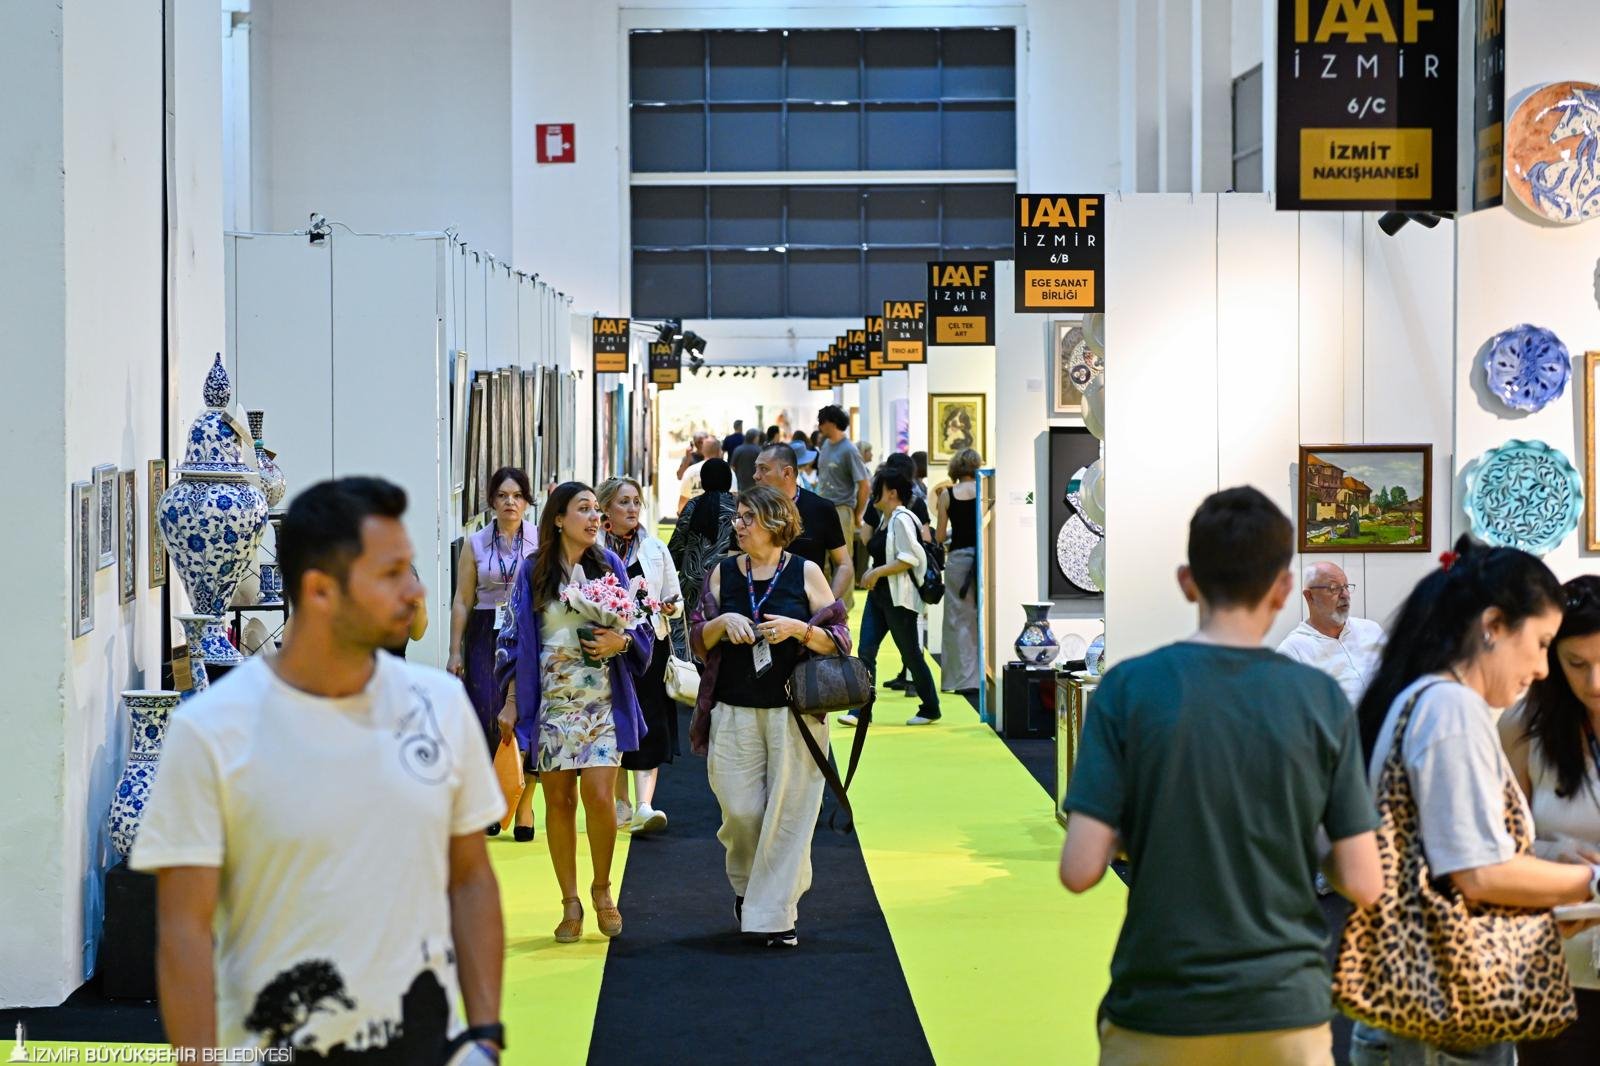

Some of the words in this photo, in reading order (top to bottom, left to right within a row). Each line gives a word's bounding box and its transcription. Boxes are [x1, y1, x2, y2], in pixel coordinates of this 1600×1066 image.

[1295, 0, 1434, 43] IAAF
[1294, 49, 1440, 79] İZMİR
[1347, 96, 1387, 119] 6/C
[1329, 141, 1392, 160] İZMİT
[1313, 162, 1420, 182] NAKIŞHANESİ
[1020, 197, 1099, 228] IAAF
[1023, 232, 1096, 247] İZMİR
[1050, 253, 1069, 264] 6/B
[932, 265, 989, 287] IAAF
[1031, 279, 1052, 288] EGE
[1054, 279, 1088, 288] SANAT
[935, 290, 987, 300] İZMİR
[1041, 289, 1078, 300] BİRLİĞİ
[885, 302, 925, 319] IAAF
[594, 319, 628, 335] IAAF
